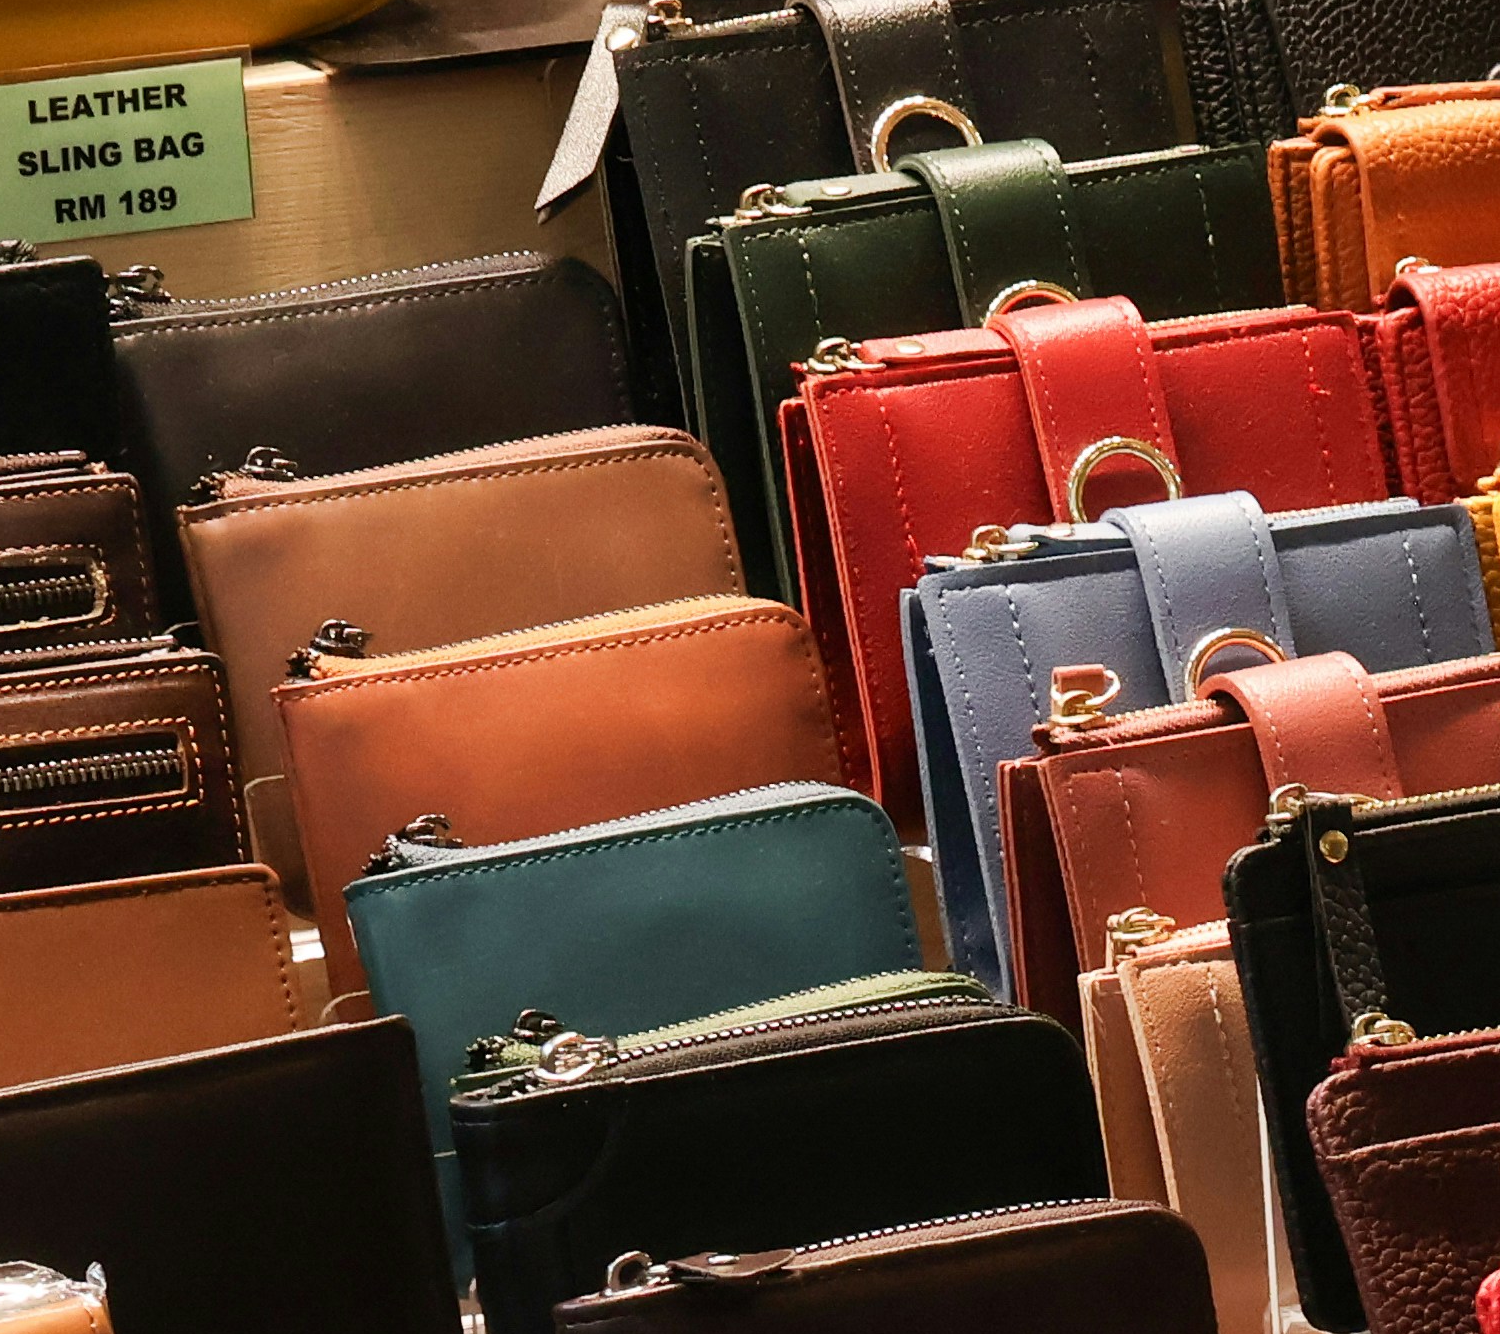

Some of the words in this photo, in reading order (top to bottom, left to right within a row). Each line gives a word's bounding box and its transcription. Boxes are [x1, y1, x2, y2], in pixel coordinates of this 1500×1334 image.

[28, 83, 187, 124] LEATHER
[18, 141, 122, 177] SLING
[134, 131, 204, 164] BAG
[55, 194, 106, 223] RM
[119, 186, 177, 215] 189
